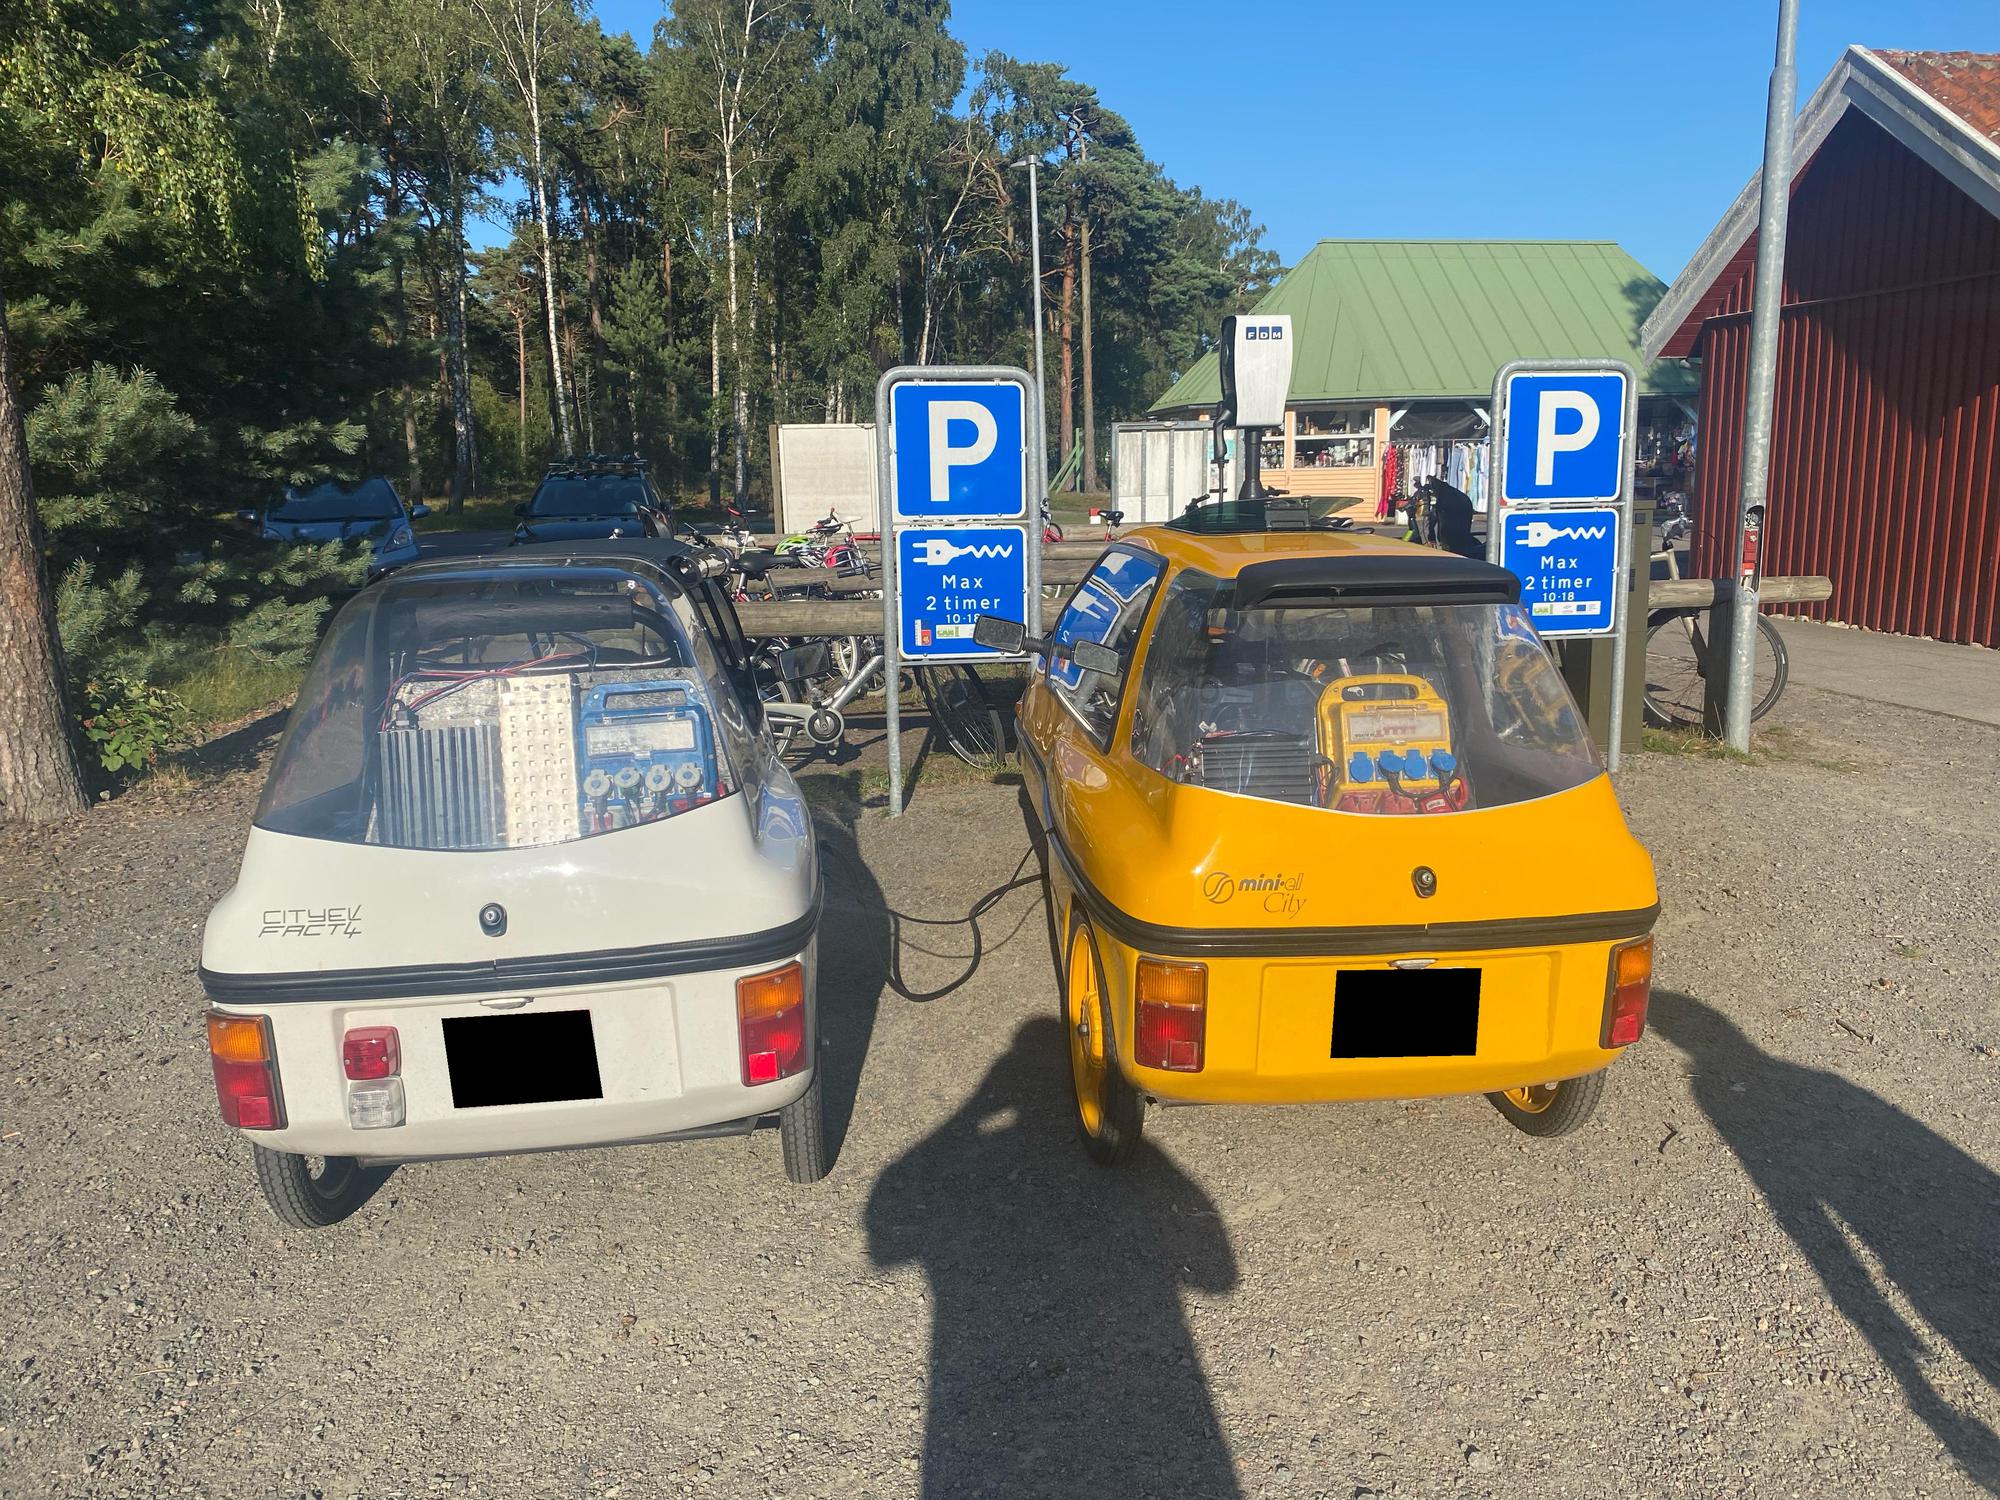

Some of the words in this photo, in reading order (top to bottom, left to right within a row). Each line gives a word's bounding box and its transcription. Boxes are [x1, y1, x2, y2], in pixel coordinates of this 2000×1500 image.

[1247, 331, 1282, 339] FDM
[1535, 390, 1600, 486] P
[928, 400, 998, 502] P
[1540, 555, 1578, 570] Max
[942, 575, 983, 589] Max
[1525, 576, 1535, 590] 2
[1541, 575, 1592, 590] timer
[926, 596, 937, 610] 2
[944, 596, 1000, 610] timer
[1542, 591, 1575, 602] 10-18
[1263, 892, 1307, 919] City
